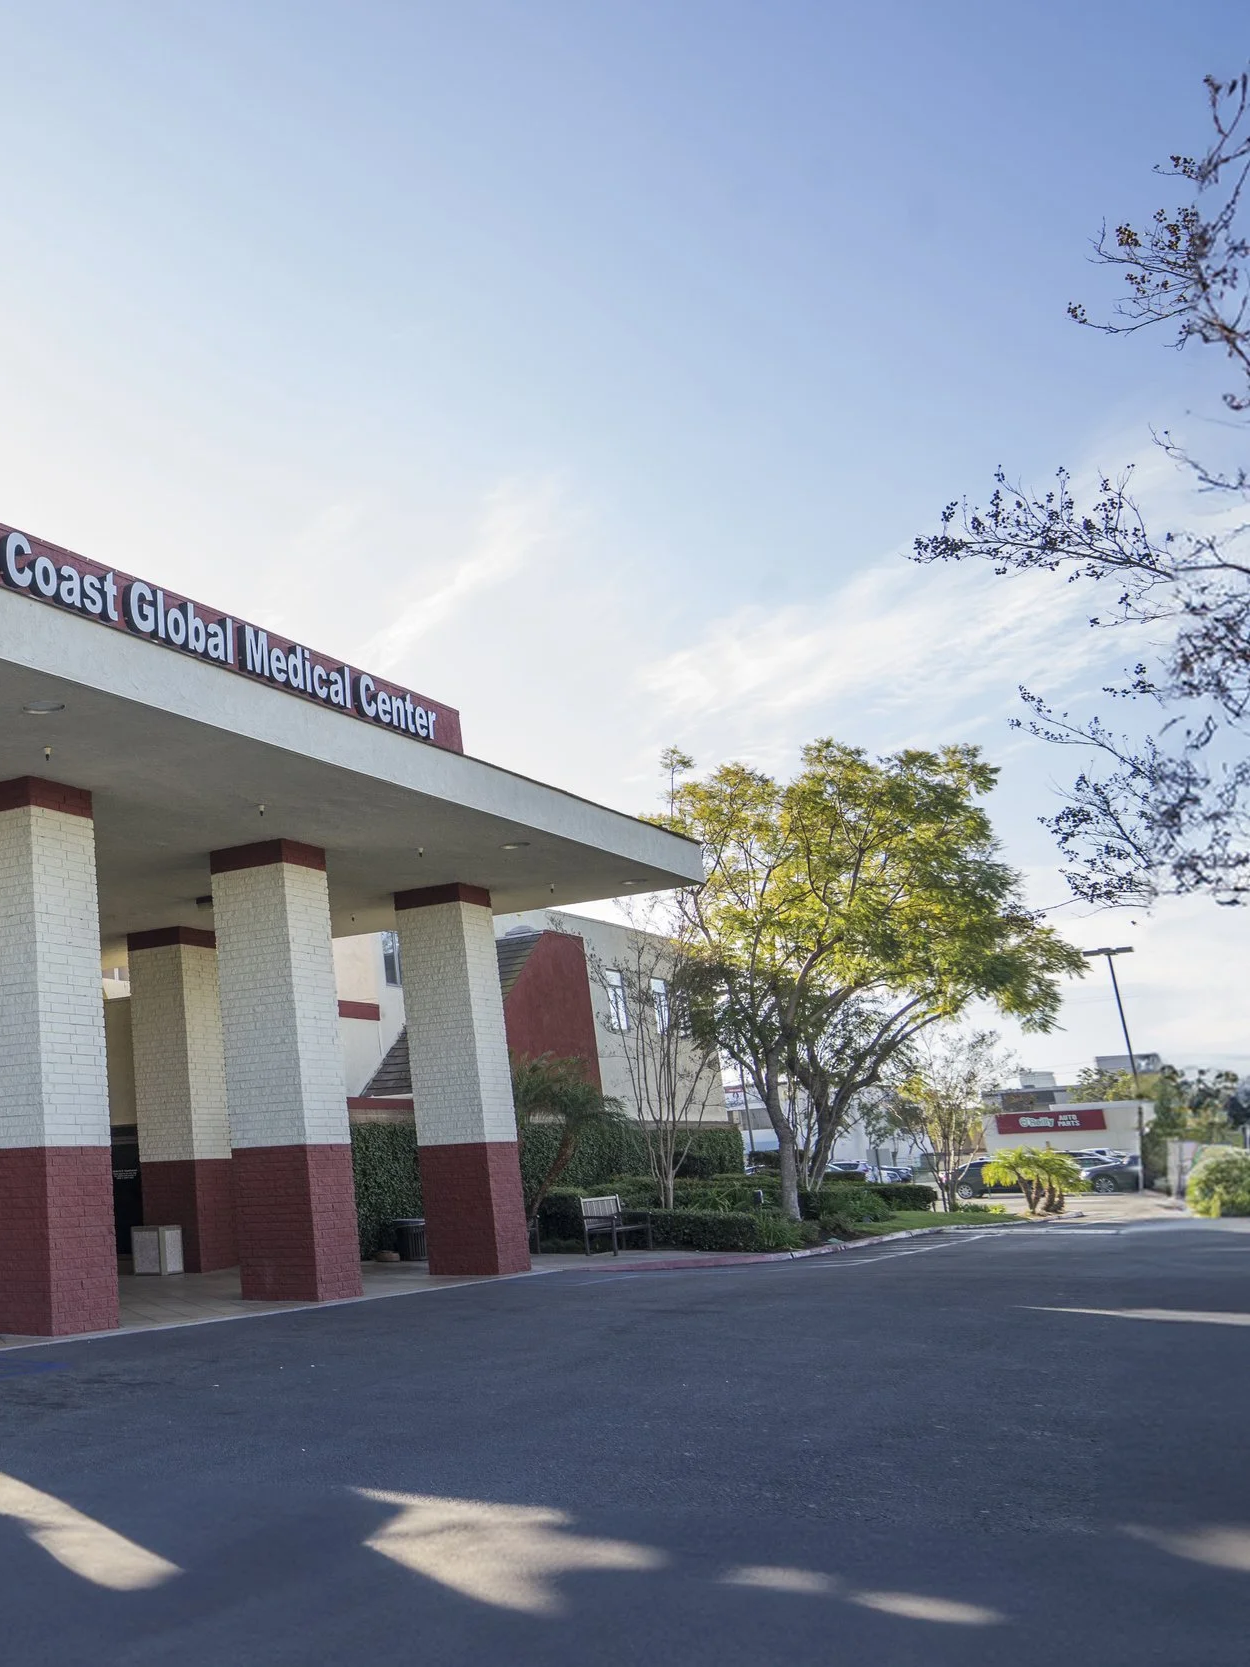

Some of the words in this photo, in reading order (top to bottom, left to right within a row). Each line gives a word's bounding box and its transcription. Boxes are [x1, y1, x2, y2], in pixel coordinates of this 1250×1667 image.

[2, 532, 119, 622] Coast
[127, 581, 234, 664] Global
[243, 624, 351, 709] Medical
[357, 674, 437, 740] Center
